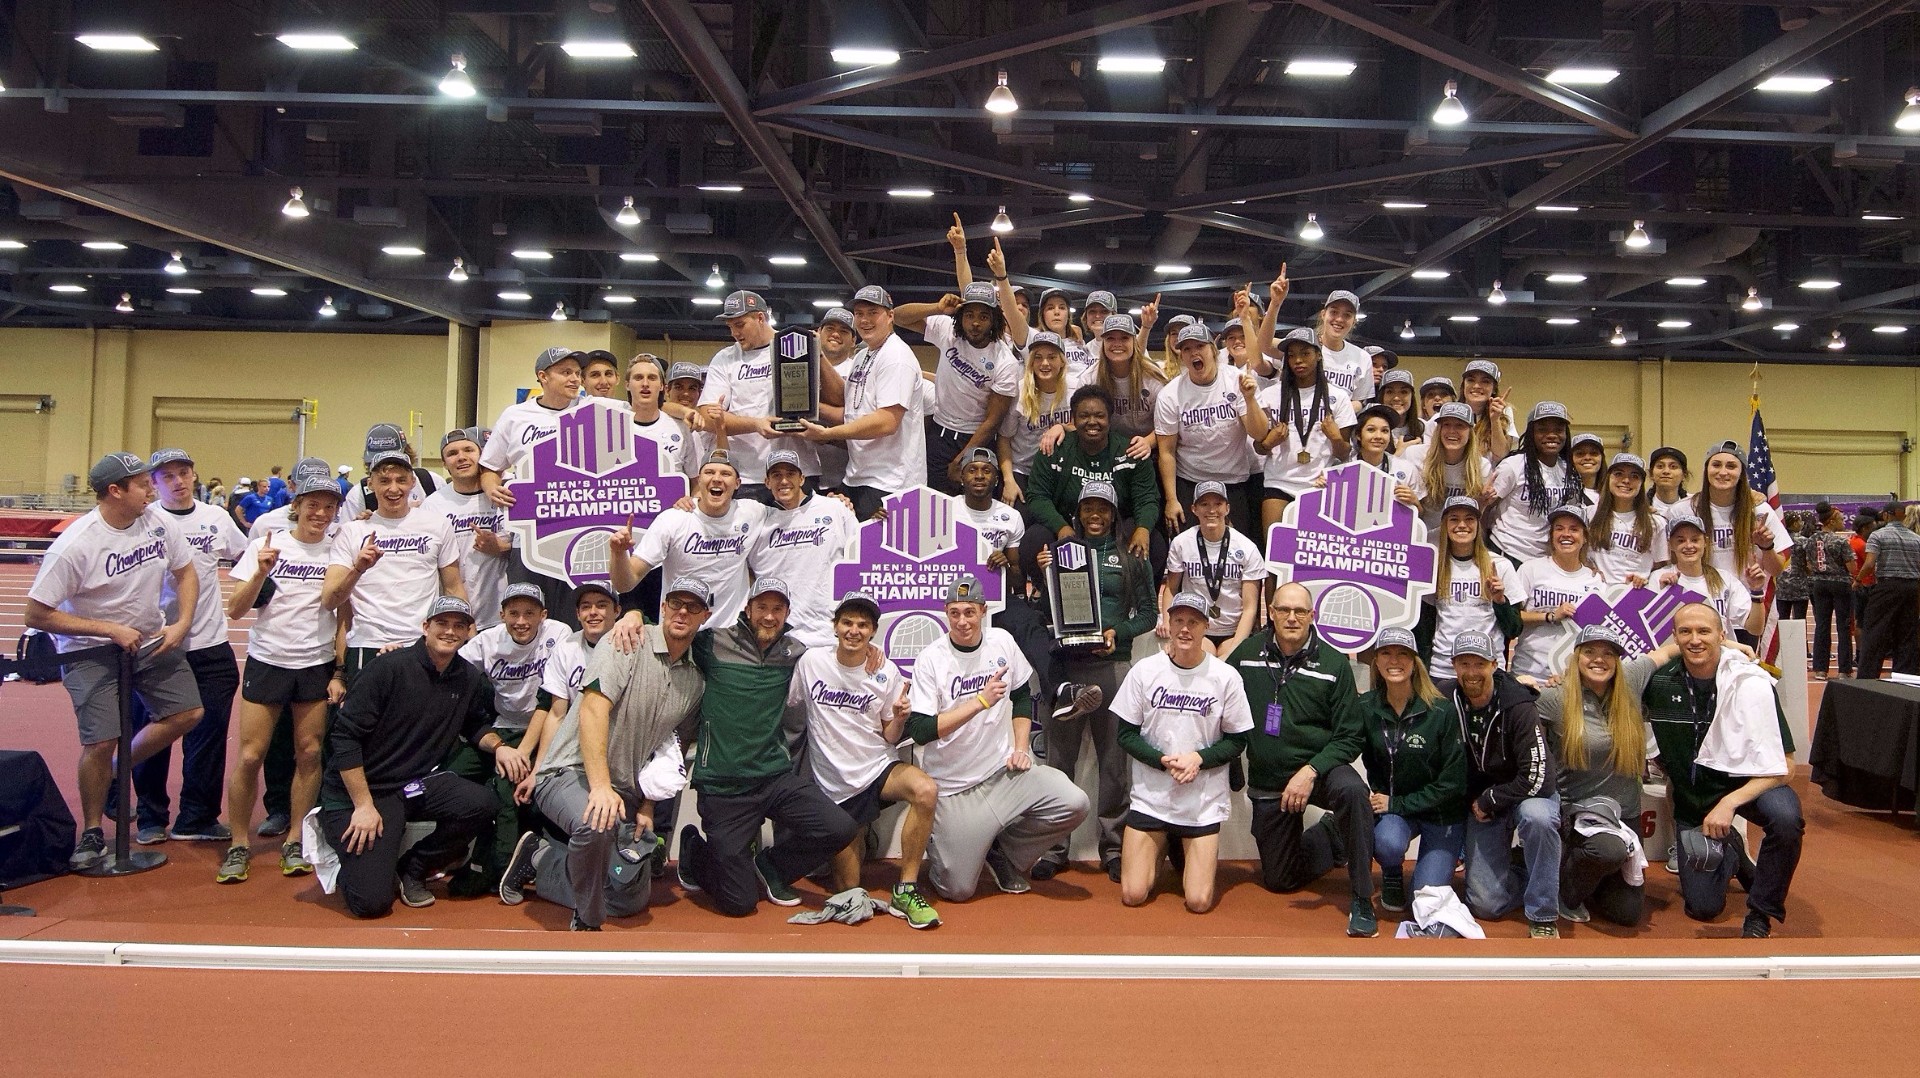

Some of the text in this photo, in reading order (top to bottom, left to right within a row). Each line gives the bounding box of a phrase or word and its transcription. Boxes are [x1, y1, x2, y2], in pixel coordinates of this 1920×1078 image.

[945, 347, 992, 389] Champions
[547, 477, 647, 489] MEN'S INDOOR
[536, 499, 662, 518] CHAMPIONS
[684, 532, 749, 556] Champions
[769, 526, 830, 548] Champions
[1297, 530, 1409, 552] WOMEN'S INDOOR
[105, 539, 166, 577] Champions
[871, 563, 966, 572] MEN'S INDOOR
[1294, 553, 1410, 579] CHAMPIONS
[1064, 581, 1086, 589] WEST
[1332, 616, 1339, 624] 2
[1342, 617, 1349, 625] 3
[1353, 618, 1360, 627] 4
[811, 679, 878, 709] Champions
[1151, 686, 1218, 713] Champions
